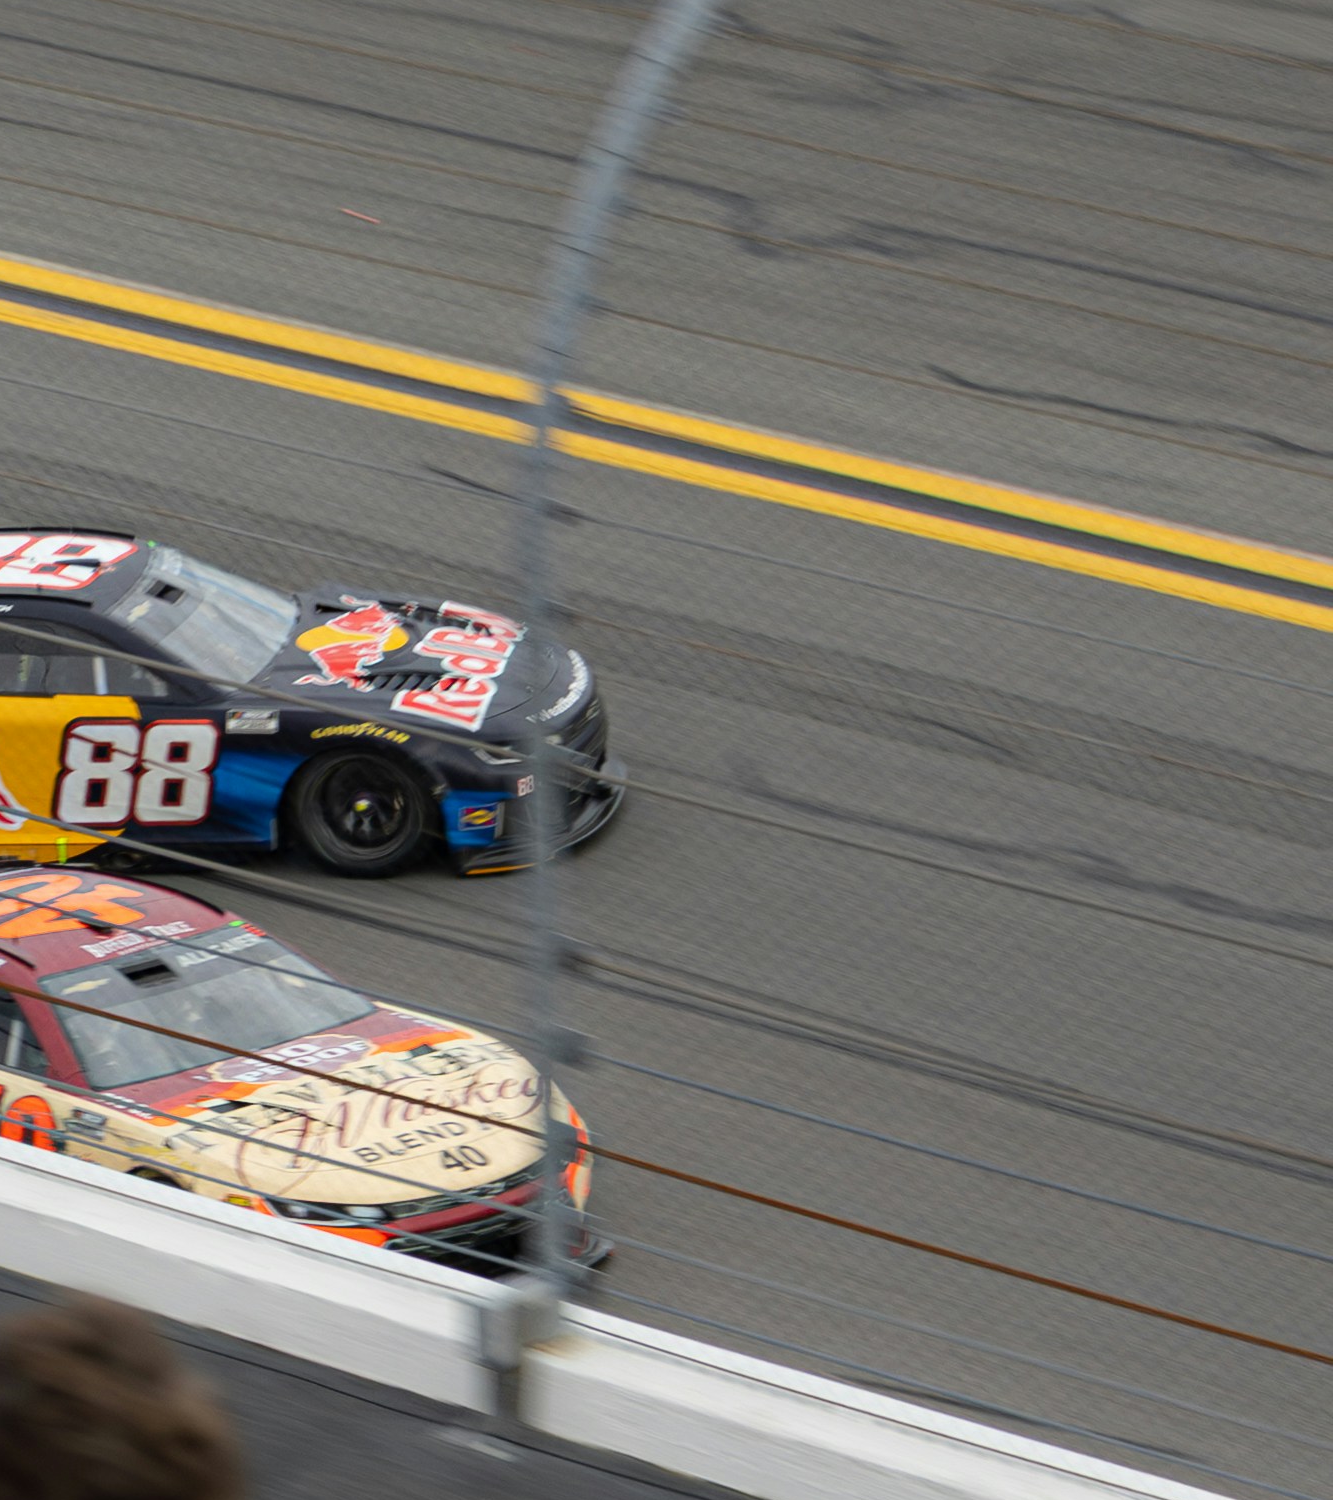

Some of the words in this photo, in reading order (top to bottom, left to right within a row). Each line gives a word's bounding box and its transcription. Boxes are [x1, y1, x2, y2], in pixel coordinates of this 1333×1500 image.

[310, 721, 411, 745] GOODYEAR
[55, 718, 220, 829] 88
[235, 1039, 370, 1083] PROOF
[352, 1119, 467, 1164] BLEND
[439, 1144, 490, 1172] 40
